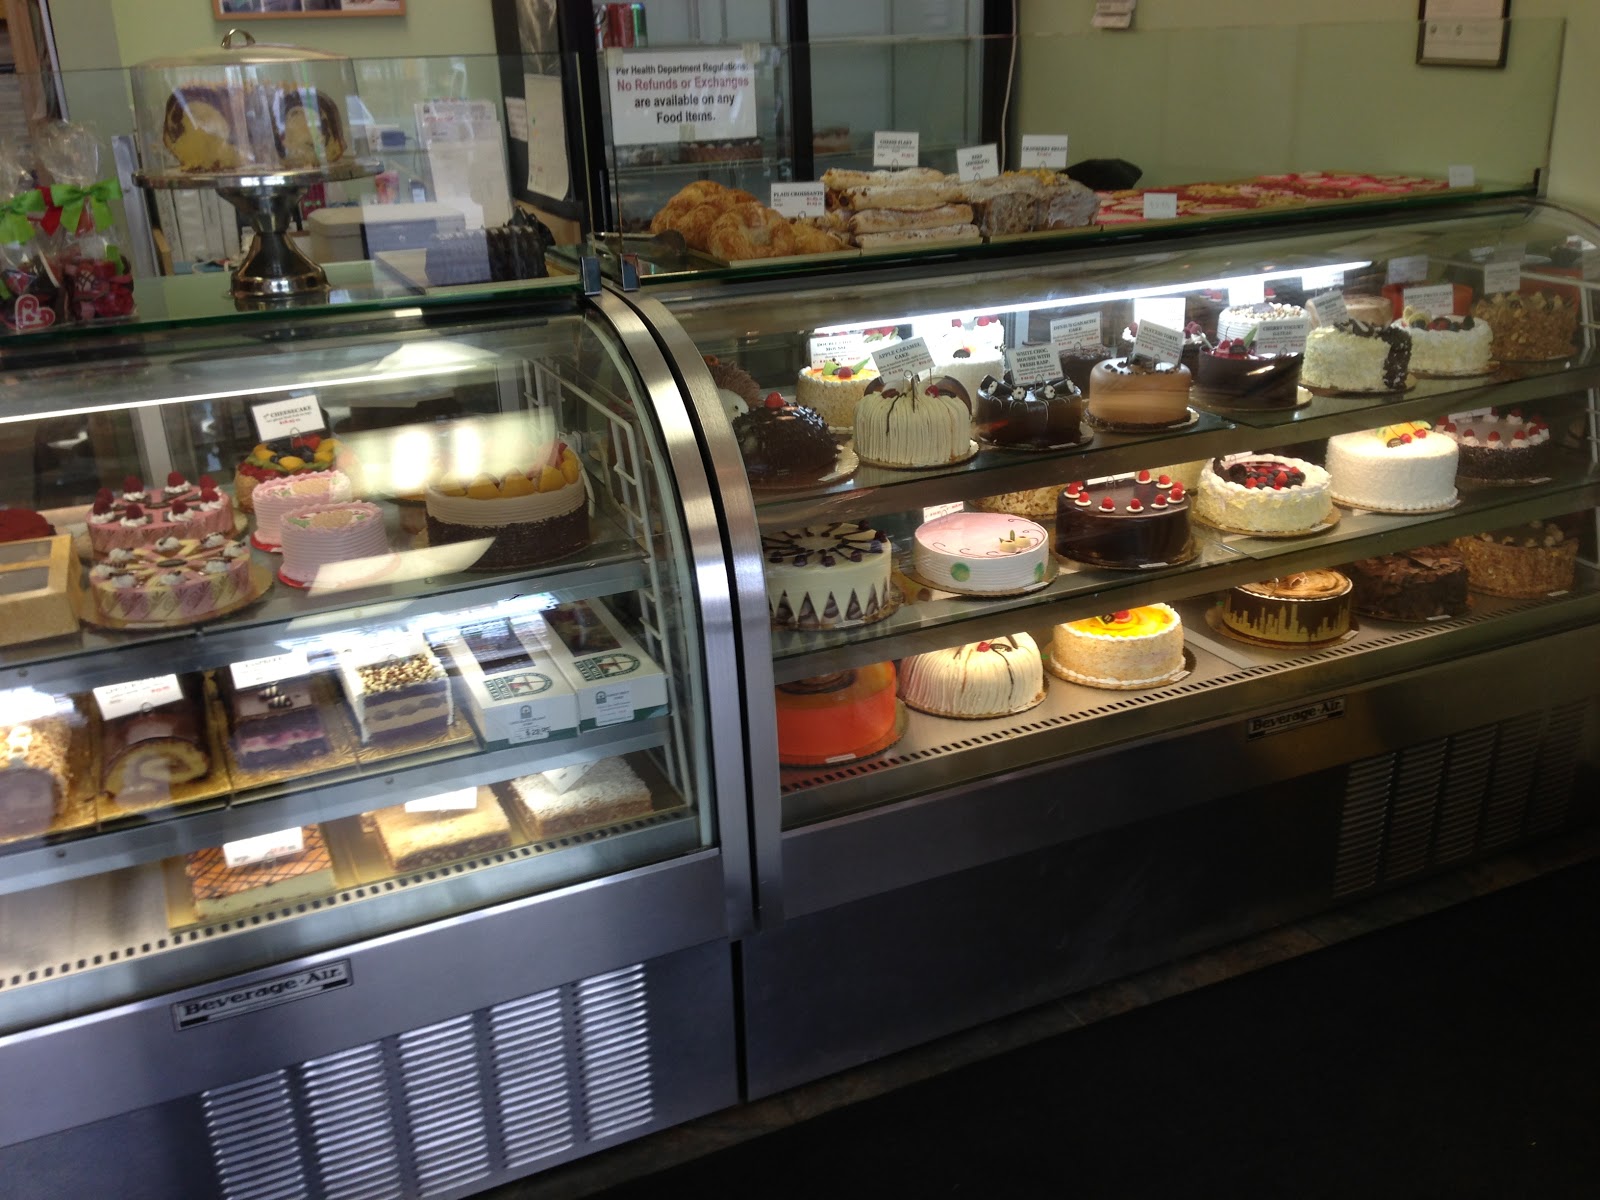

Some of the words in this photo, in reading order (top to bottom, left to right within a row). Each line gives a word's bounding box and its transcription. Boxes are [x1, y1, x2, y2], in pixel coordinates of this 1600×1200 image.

[631, 64, 656, 75] Health
[657, 63, 701, 75] Department
[617, 80, 632, 92] No
[635, 77, 678, 91] Refunds
[681, 79, 692, 89] or
[694, 76, 749, 89] Exchanges
[634, 98, 651, 108] are
[653, 93, 699, 107] available
[701, 95, 714, 104] on
[717, 94, 736, 106] any
[656, 111, 683, 124] Food
[878, 350, 896, 360] APPLE
[896, 342, 922, 354] CARAMEL
[894, 352, 910, 360] CAKE
[270, 405, 312, 418] CHEESECAKE
